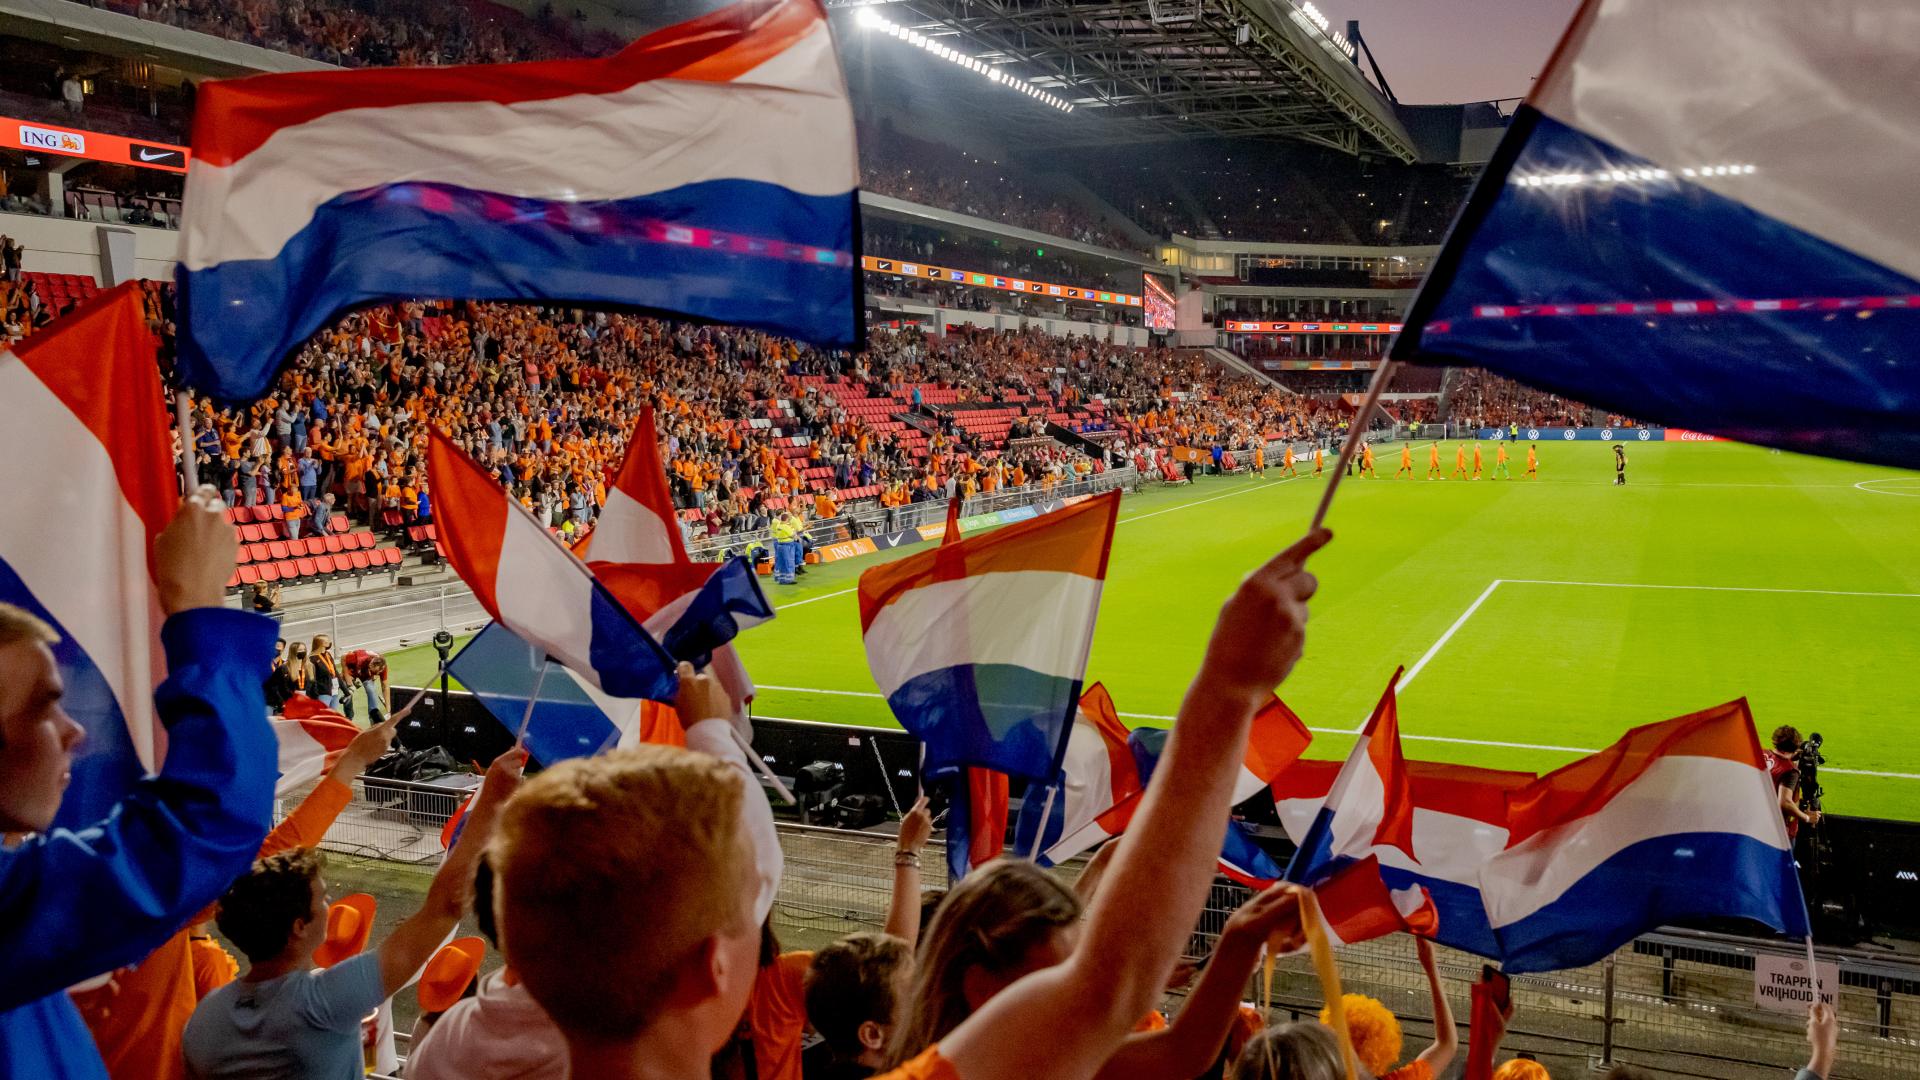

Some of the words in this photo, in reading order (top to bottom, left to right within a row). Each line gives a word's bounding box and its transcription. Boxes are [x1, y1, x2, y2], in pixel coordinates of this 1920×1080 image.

[24, 132, 57, 147] ING
[831, 545, 854, 560] ING
[1759, 984, 1833, 1005] VRIJHOUDN!
